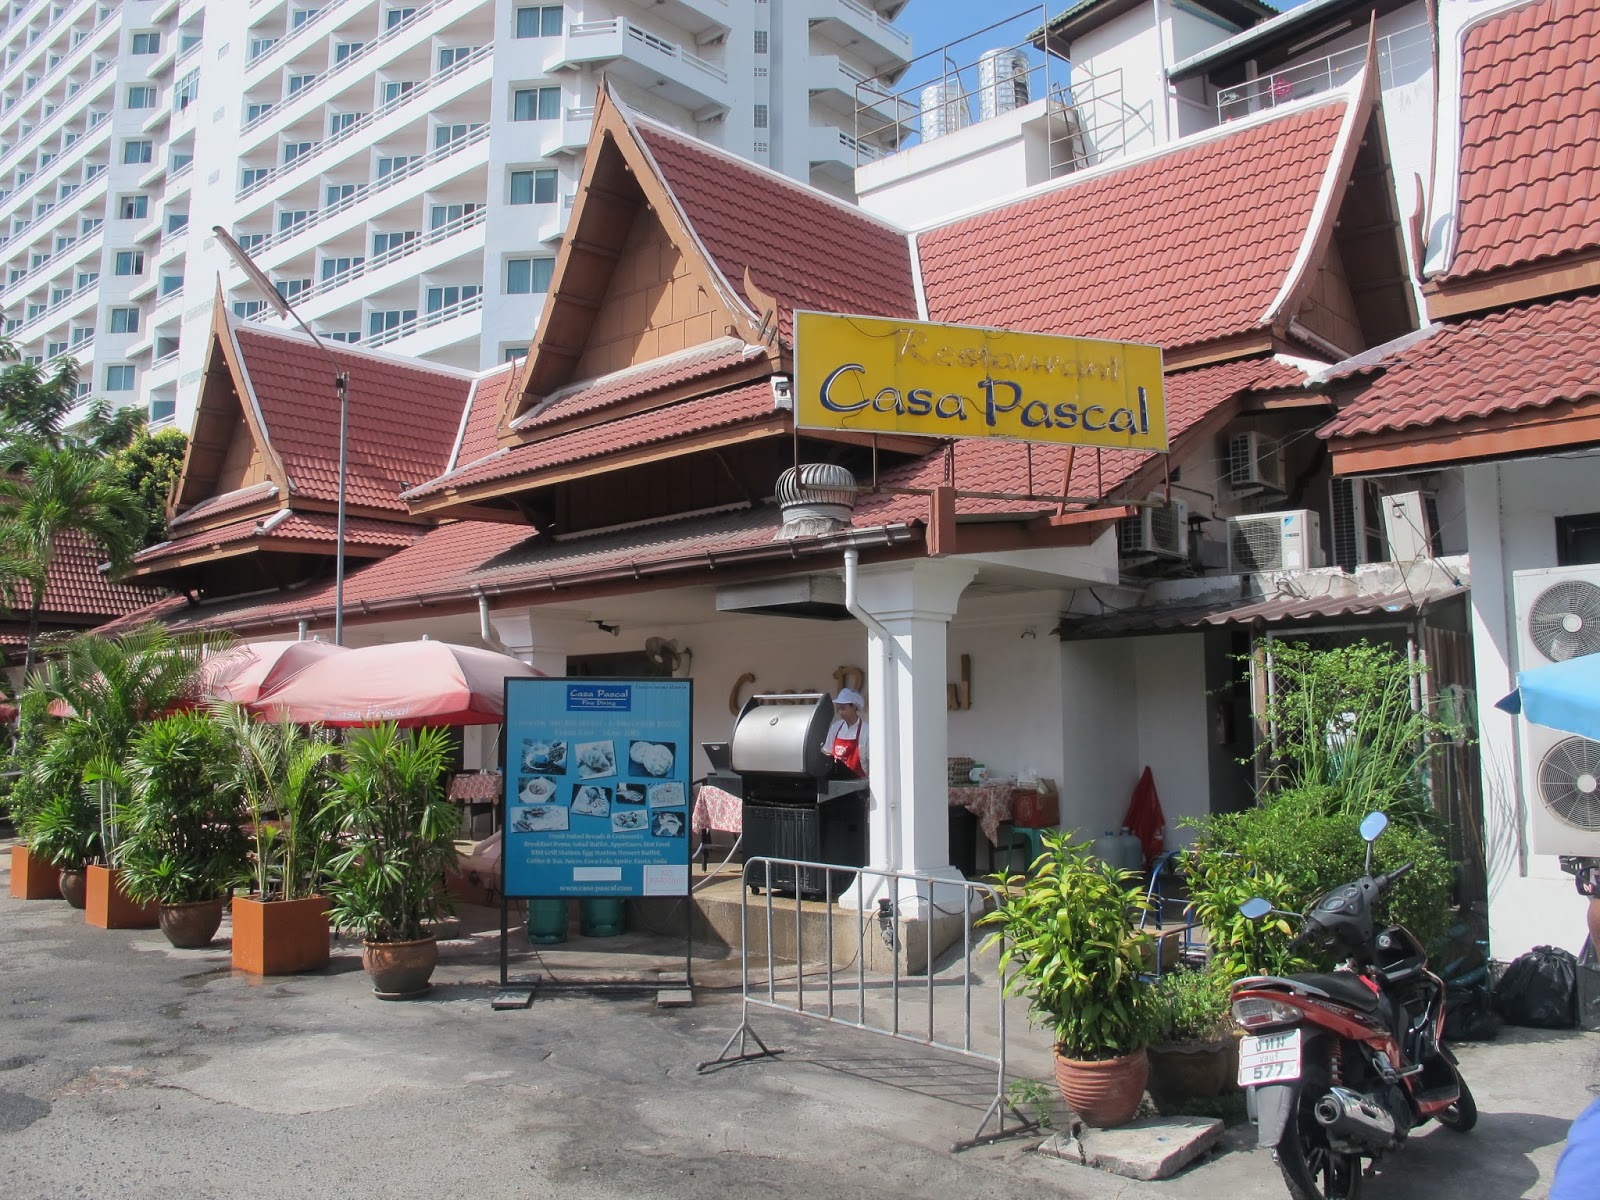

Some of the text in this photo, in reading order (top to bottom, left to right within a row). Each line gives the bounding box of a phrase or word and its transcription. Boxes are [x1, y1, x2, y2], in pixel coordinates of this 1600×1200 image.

[896, 328, 1121, 382] Restaurant
[819, 363, 1150, 435] Casa Pascal
[570, 689, 629, 698] Casa Pascal
[366, 703, 410, 718] Pascal
[596, 699, 616, 707] Dining
[1253, 1061, 1285, 1080] 577
